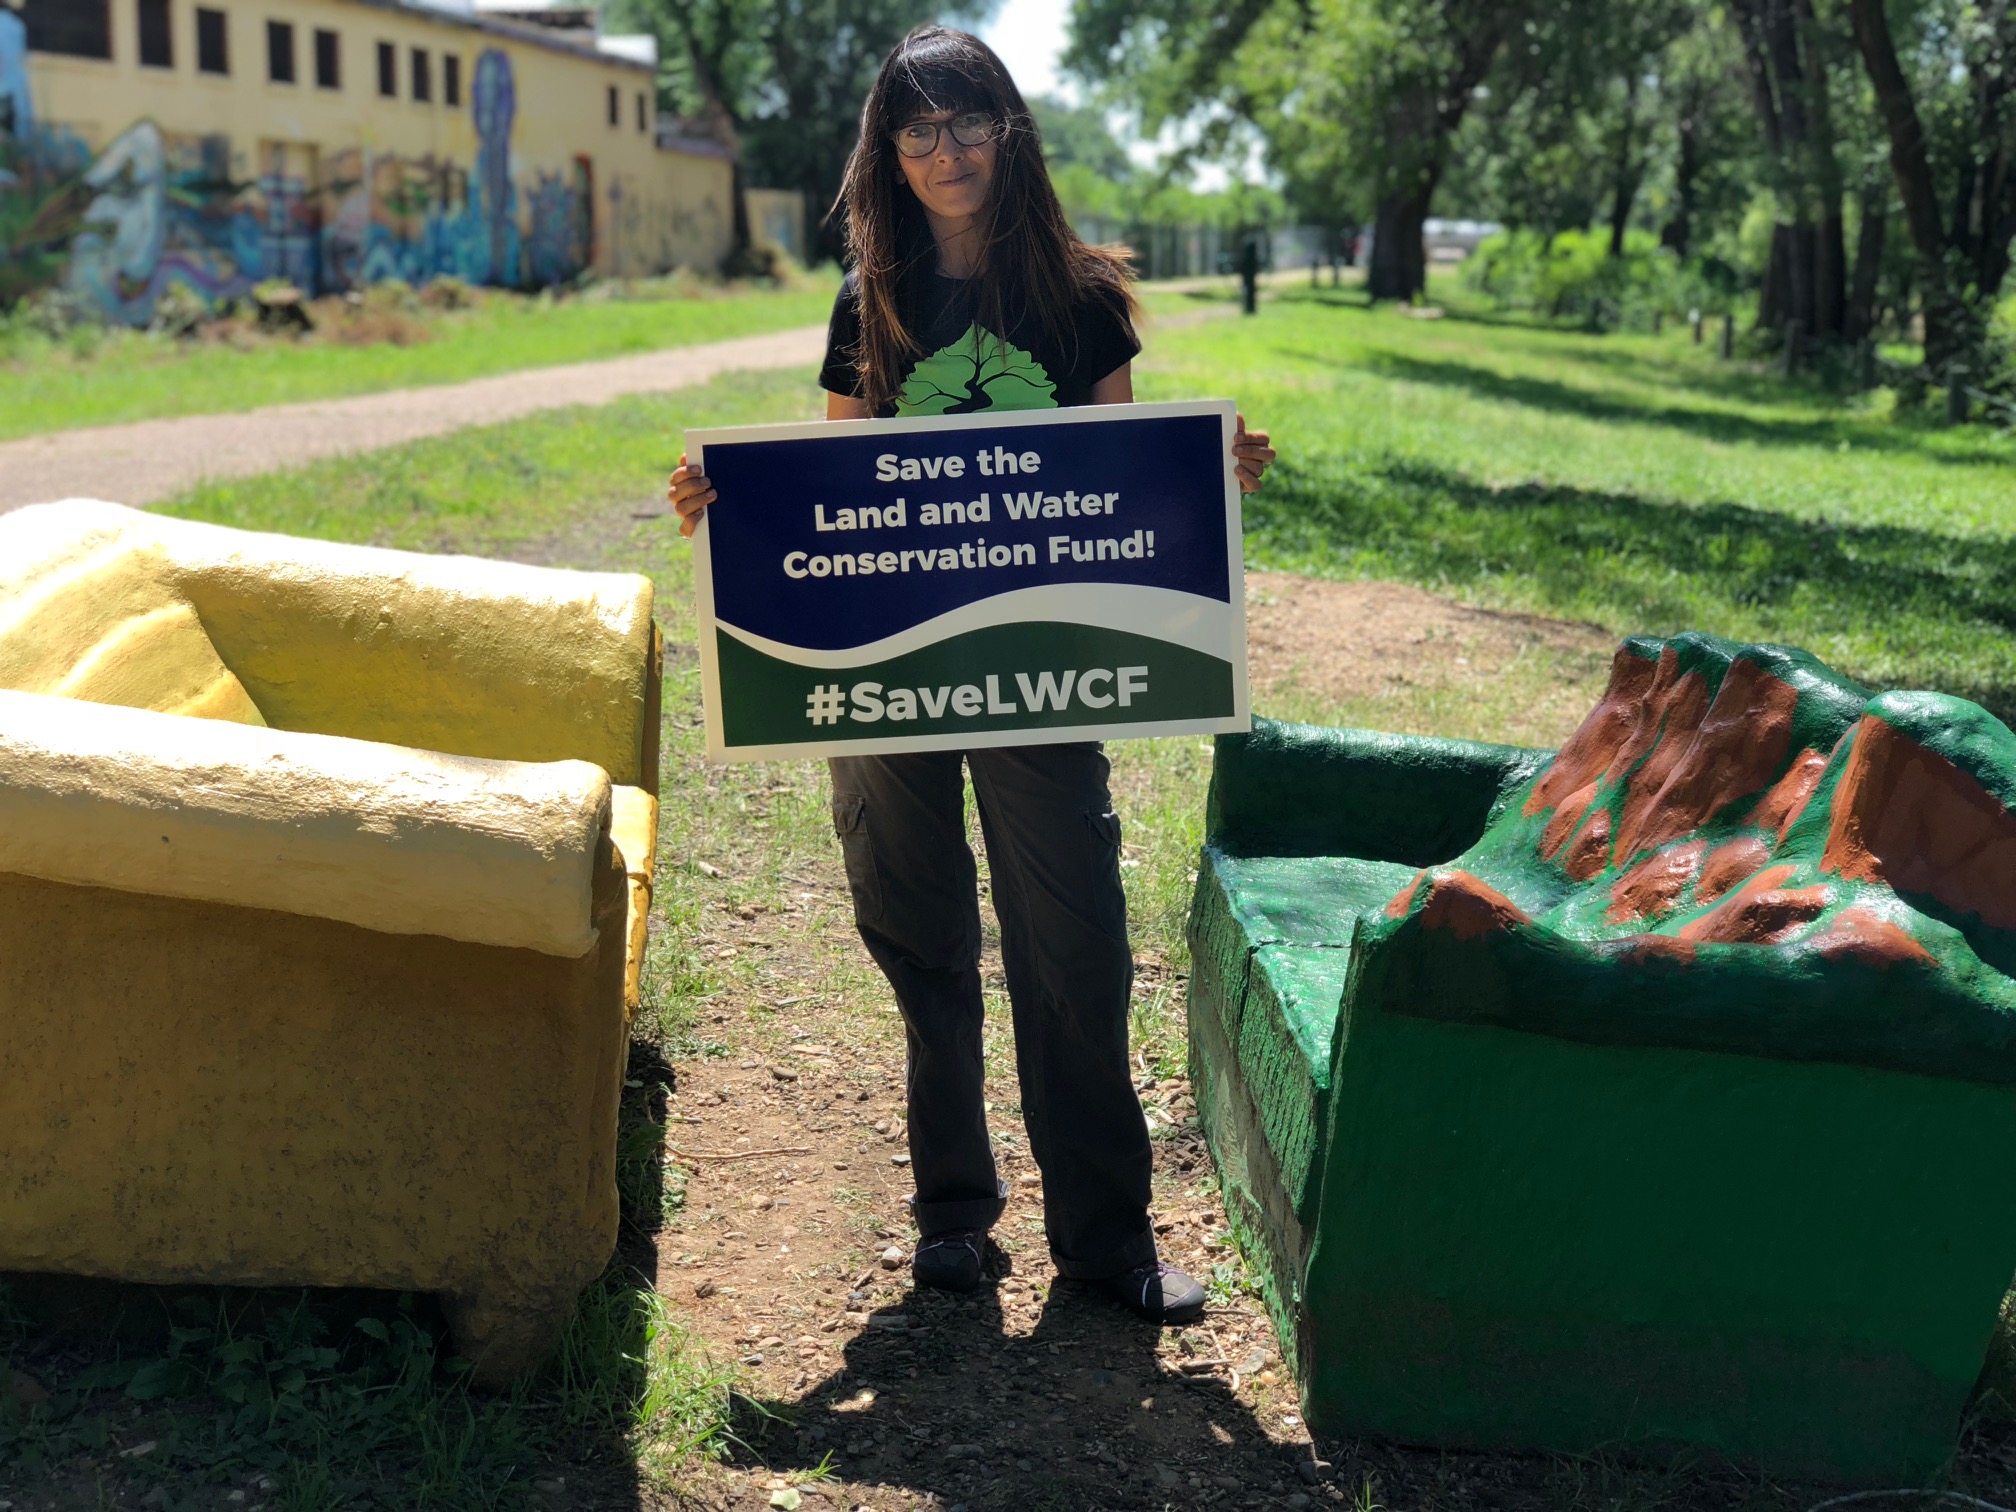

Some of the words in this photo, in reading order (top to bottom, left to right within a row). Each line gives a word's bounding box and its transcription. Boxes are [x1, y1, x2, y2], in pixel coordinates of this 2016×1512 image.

[875, 453, 966, 482] Save
[977, 445, 1041, 475] the
[814, 497, 907, 532] Land
[919, 493, 993, 526] and
[1002, 490, 1119, 520] Water
[783, 537, 1036, 579] Conservation
[1048, 529, 1156, 564] Fund!
[805, 665, 1149, 726] #SaveLWCF
